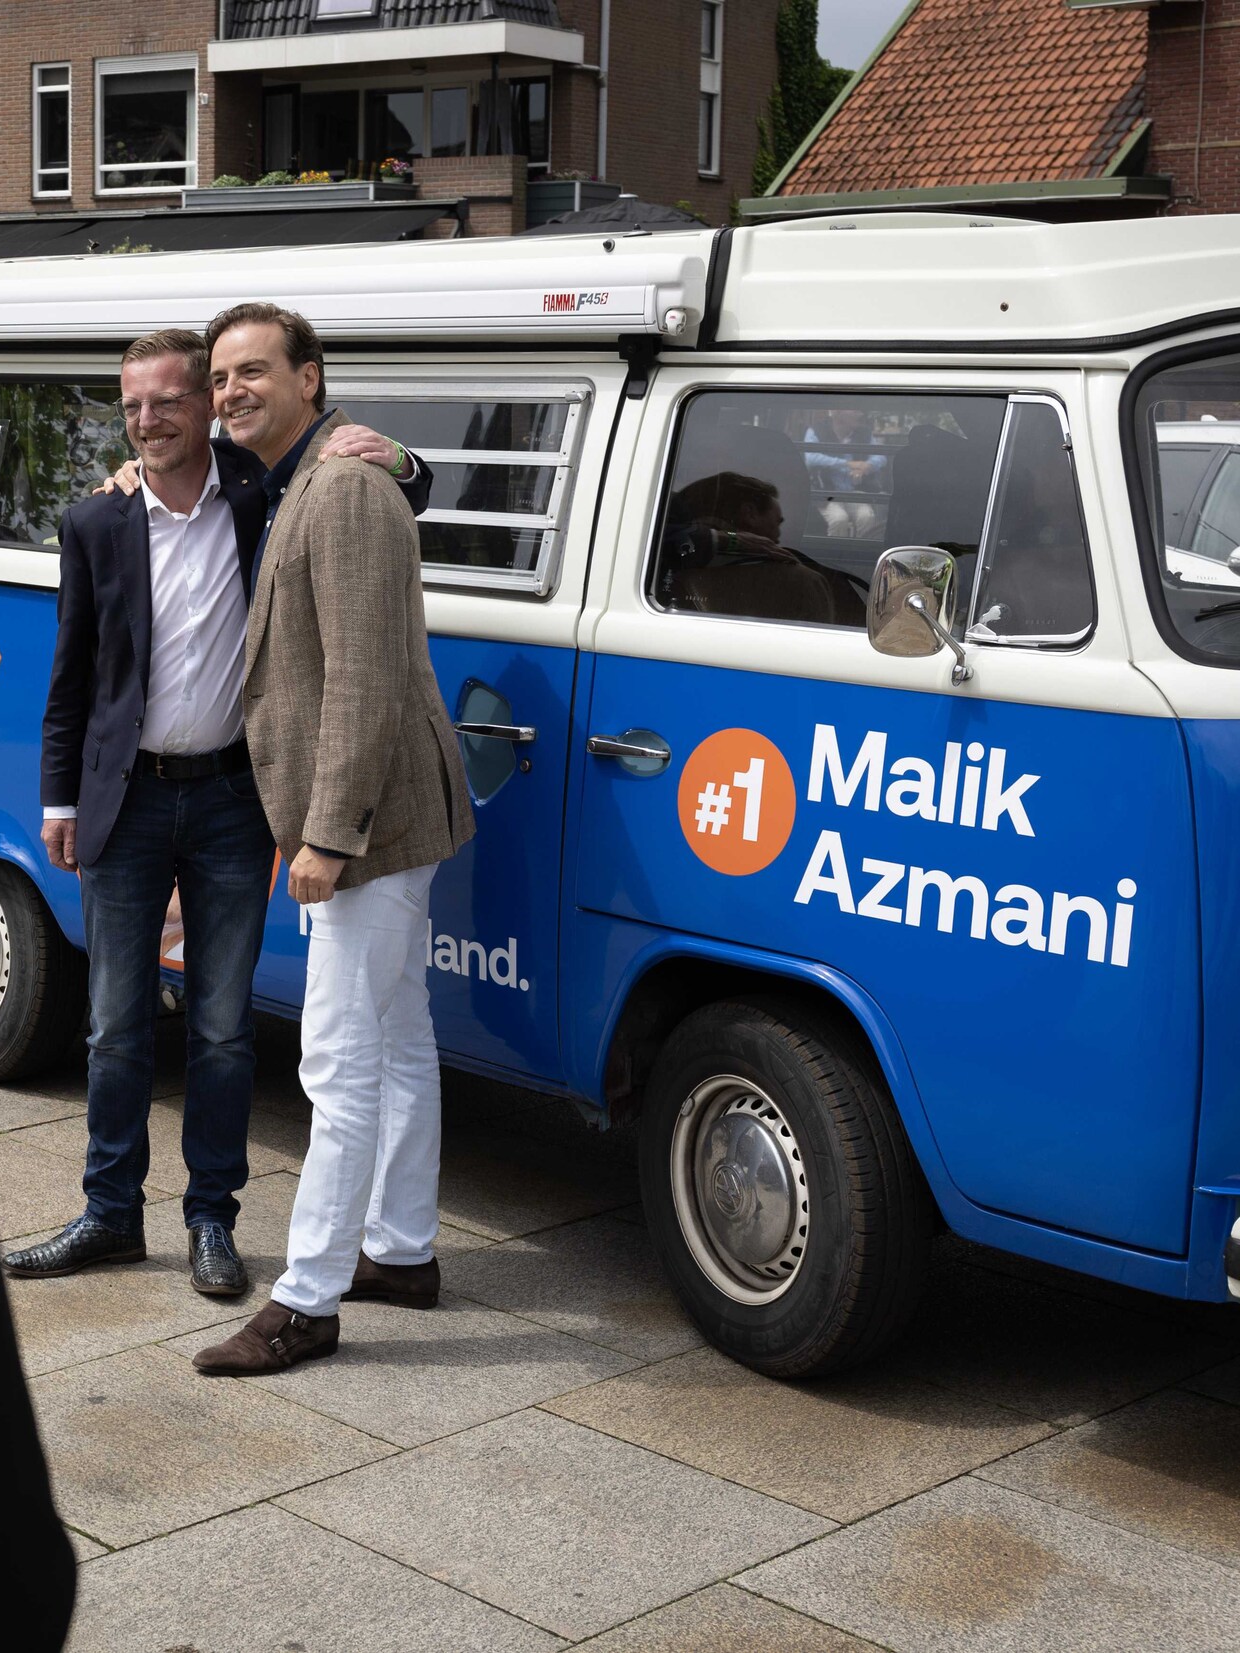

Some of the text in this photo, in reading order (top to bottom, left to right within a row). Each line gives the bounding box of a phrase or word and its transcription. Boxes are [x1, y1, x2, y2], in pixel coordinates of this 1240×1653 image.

[543, 293, 575, 312] FIAMMA
[695, 757, 765, 842] #1
[807, 723, 1041, 837] Malik
[793, 829, 1137, 967] Azmani
